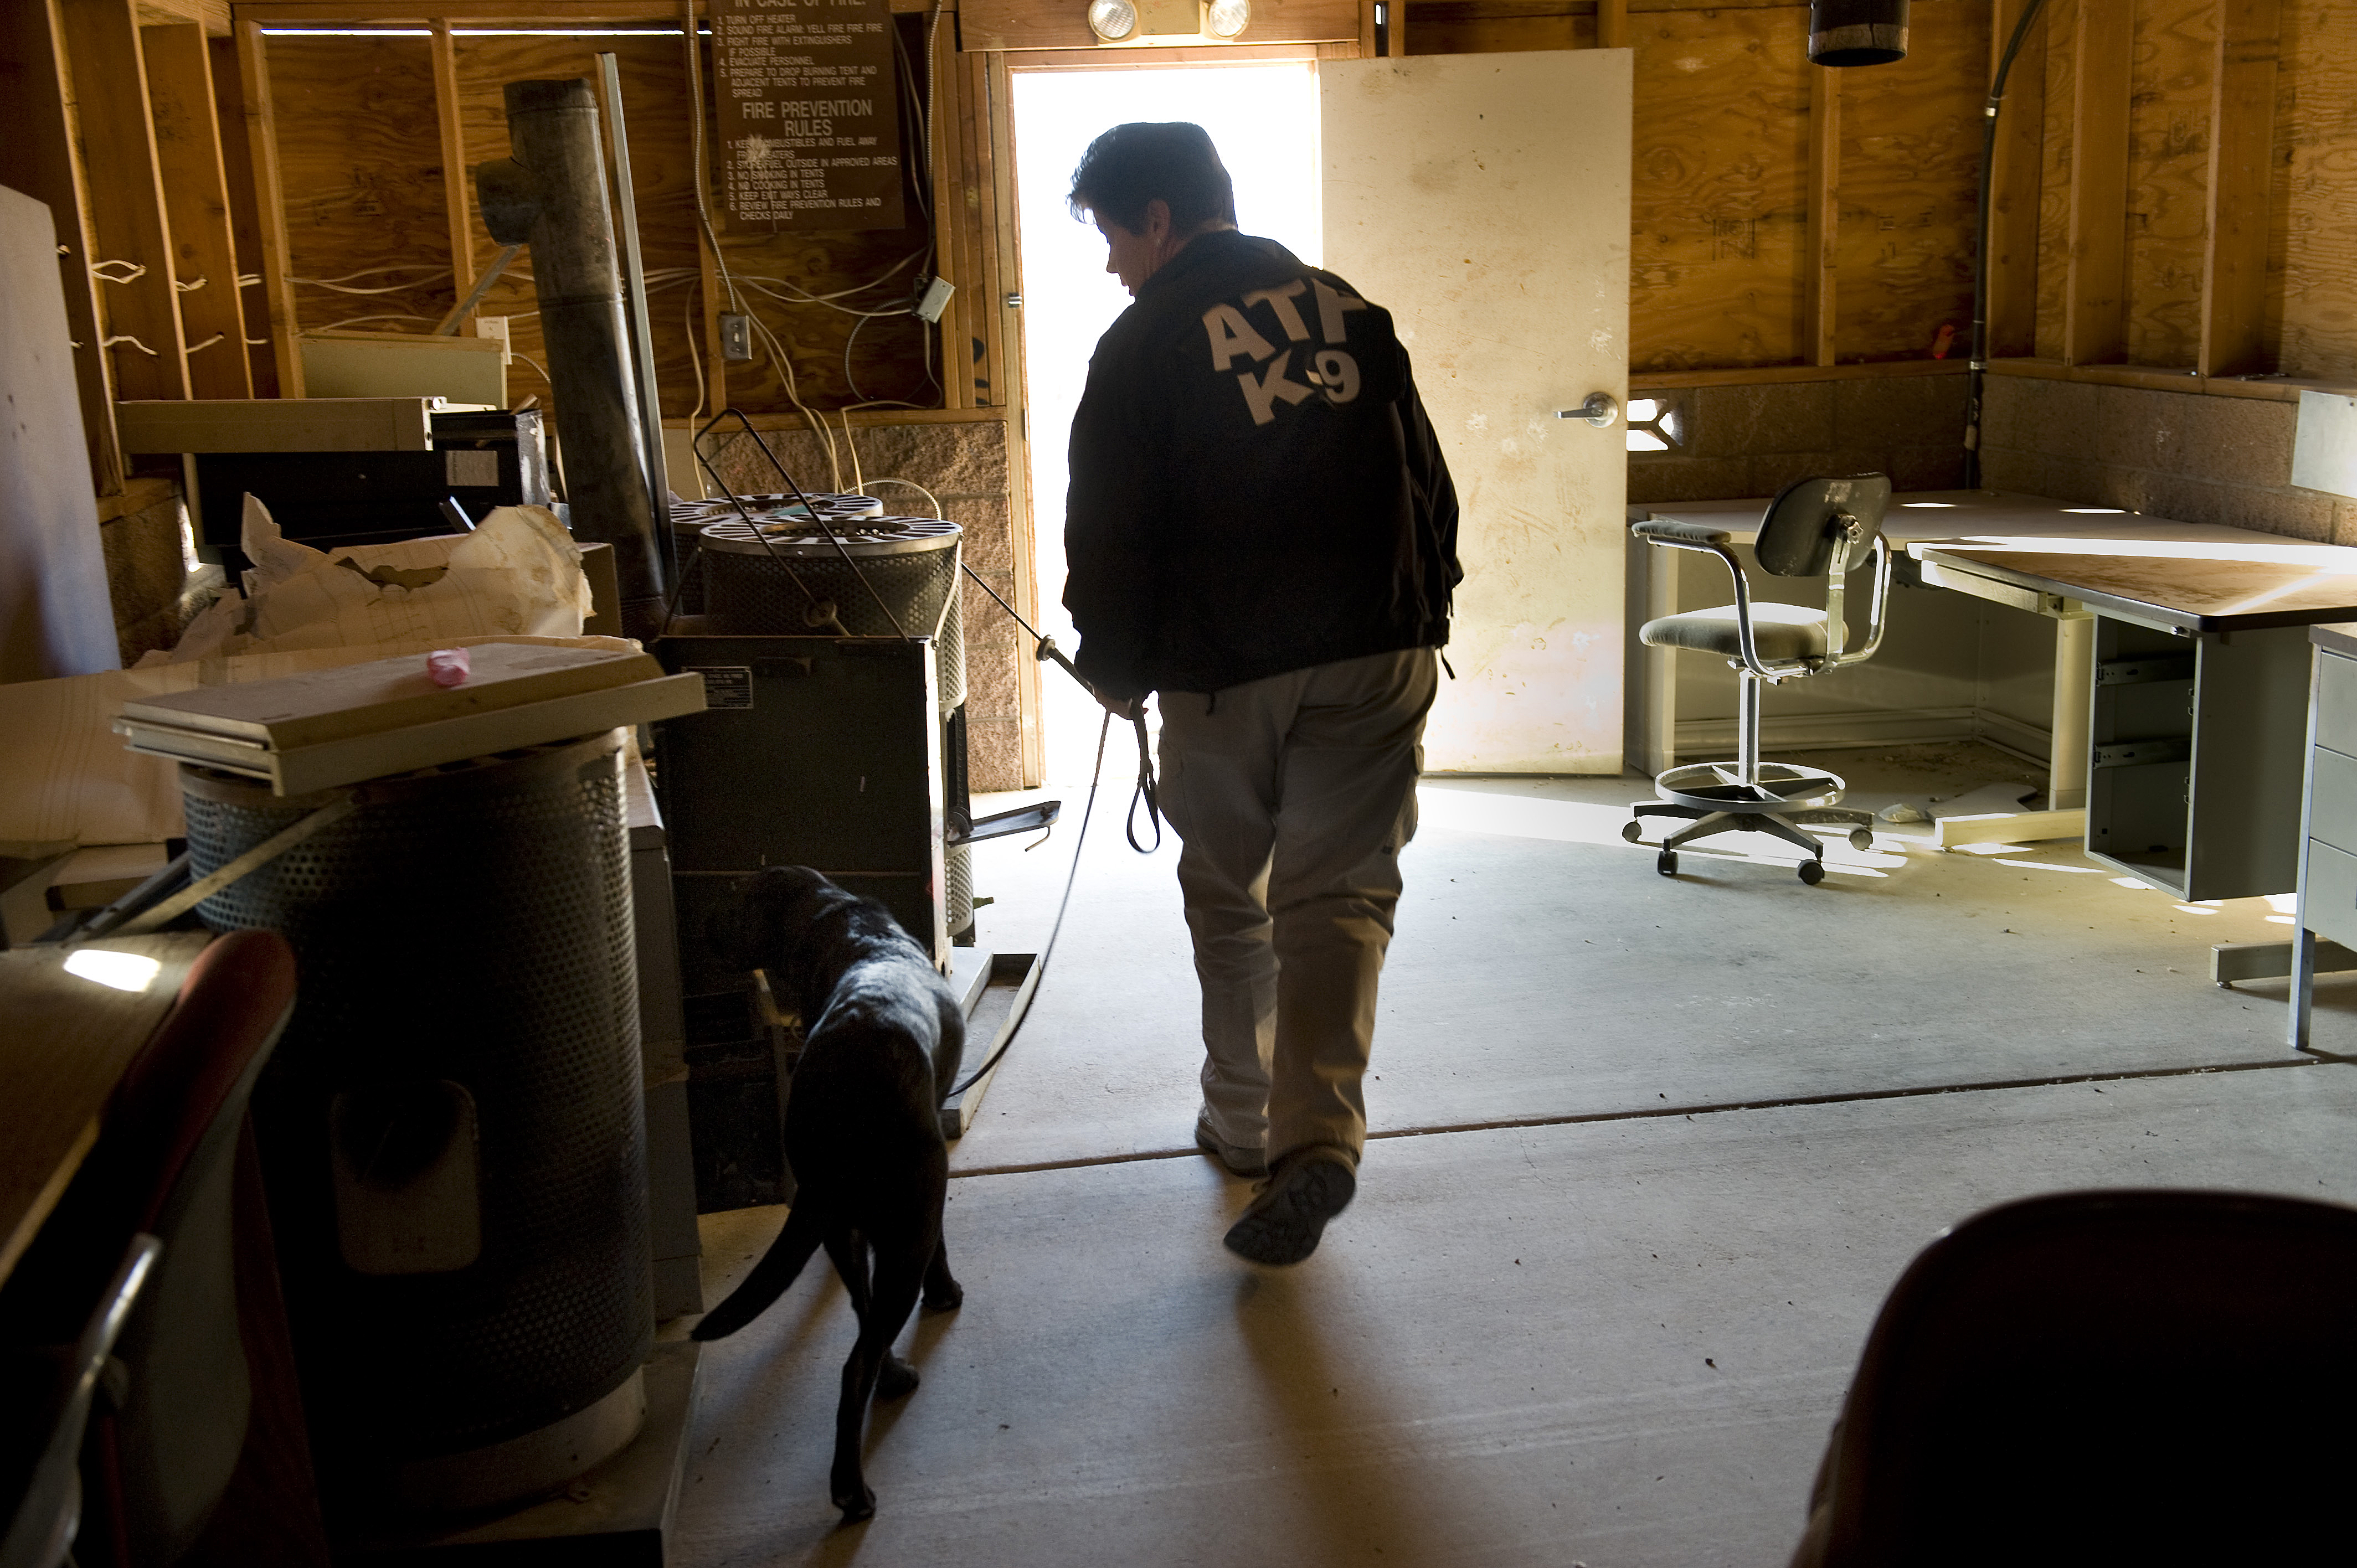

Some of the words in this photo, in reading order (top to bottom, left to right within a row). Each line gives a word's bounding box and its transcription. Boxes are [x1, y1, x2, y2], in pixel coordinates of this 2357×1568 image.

[725, 15, 747, 24] TURN
[749, 15, 764, 24] OFF
[766, 14, 796, 23] HEATER
[727, 25, 754, 35] SOUND
[756, 25, 774, 34] FIRE
[806, 24, 825, 33] YELL
[827, 24, 845, 33] FIRE
[846, 23, 864, 32] FIRE
[866, 23, 883, 32] FIRE
[727, 37, 749, 46] FIGHT
[752, 37, 769, 45] FIRE
[771, 37, 790, 45] WITH
[792, 35, 852, 45] EXTINGUISHERS
[729, 48, 736, 56] IF
[739, 47, 776, 56] POSSIBLE
[729, 57, 766, 66] EVACUATE
[730, 68, 764, 77] PREPARE
[766, 68, 777, 76] TO
[779, 67, 801, 76] DROP
[803, 66, 837, 75] BURNING
[838, 66, 858, 75] TENT
[861, 65, 877, 74] AND
[731, 78, 770, 86] ADJACENT
[772, 78, 797, 86] TENTS
[799, 77, 810, 86] TO
[812, 77, 846, 86] PREVENT
[848, 77, 866, 86] FIRE
[732, 89, 763, 97] SPREAD
[742, 102, 775, 119] FIRE
[781, 99, 873, 117] PREVENTION
[785, 119, 832, 137] RULES
[819, 137, 835, 146] AND
[836, 137, 856, 146] FUEL
[858, 137, 878, 146] AWAY
[763, 159, 784, 168] FUEL
[786, 158, 819, 168] OUTSIDE
[820, 158, 828, 167] IN
[831, 157, 870, 167] APPROVED
[872, 156, 897, 166] AREAS
[737, 171, 750, 179] NO
[752, 169, 788, 179] SMOKING
[789, 170, 798, 178] IN
[800, 168, 825, 178] TENTS
[738, 181, 750, 190] NO
[752, 180, 788, 190] COOKING
[790, 180, 799, 189] IN
[800, 179, 825, 188] TENTS
[739, 191, 759, 200] KEEP
[761, 190, 778, 200] EXIT
[780, 190, 801, 199] WAYS
[802, 189, 828, 199] CLEAR
[739, 202, 768, 210] REVIEW
[771, 200, 788, 210] FIRE
[790, 199, 836, 209] PREVENTION
[838, 198, 863, 207] RULES
[865, 198, 882, 207] AND
[740, 211, 771, 220] CHECKS
[773, 210, 793, 219] DAILY
[1202, 277, 1368, 372] ATF
[1237, 348, 1361, 426] K-9
